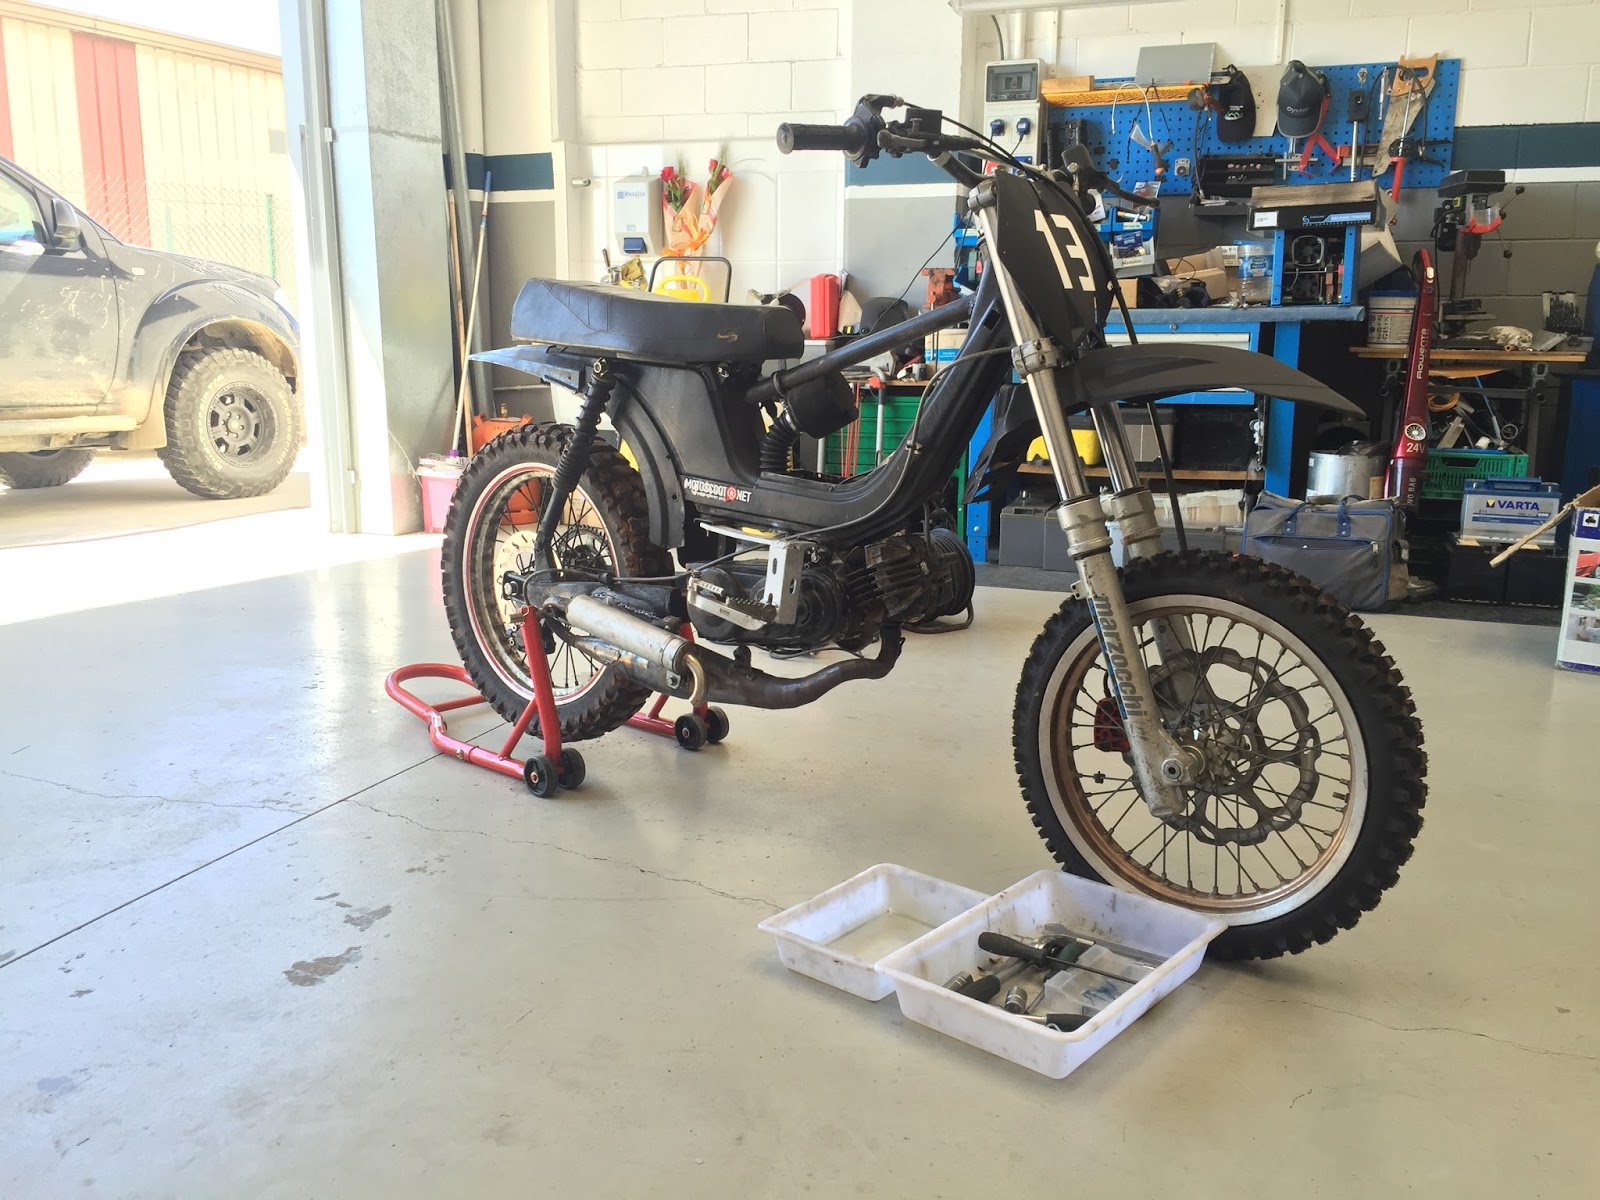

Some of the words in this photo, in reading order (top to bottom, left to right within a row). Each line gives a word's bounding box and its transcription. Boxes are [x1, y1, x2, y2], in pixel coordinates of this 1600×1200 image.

[1034, 209, 1096, 291] 13
[1406, 442, 1426, 454] 24V
[1497, 499, 1540, 511] VARTA
[1094, 595, 1149, 717] marzocchi
